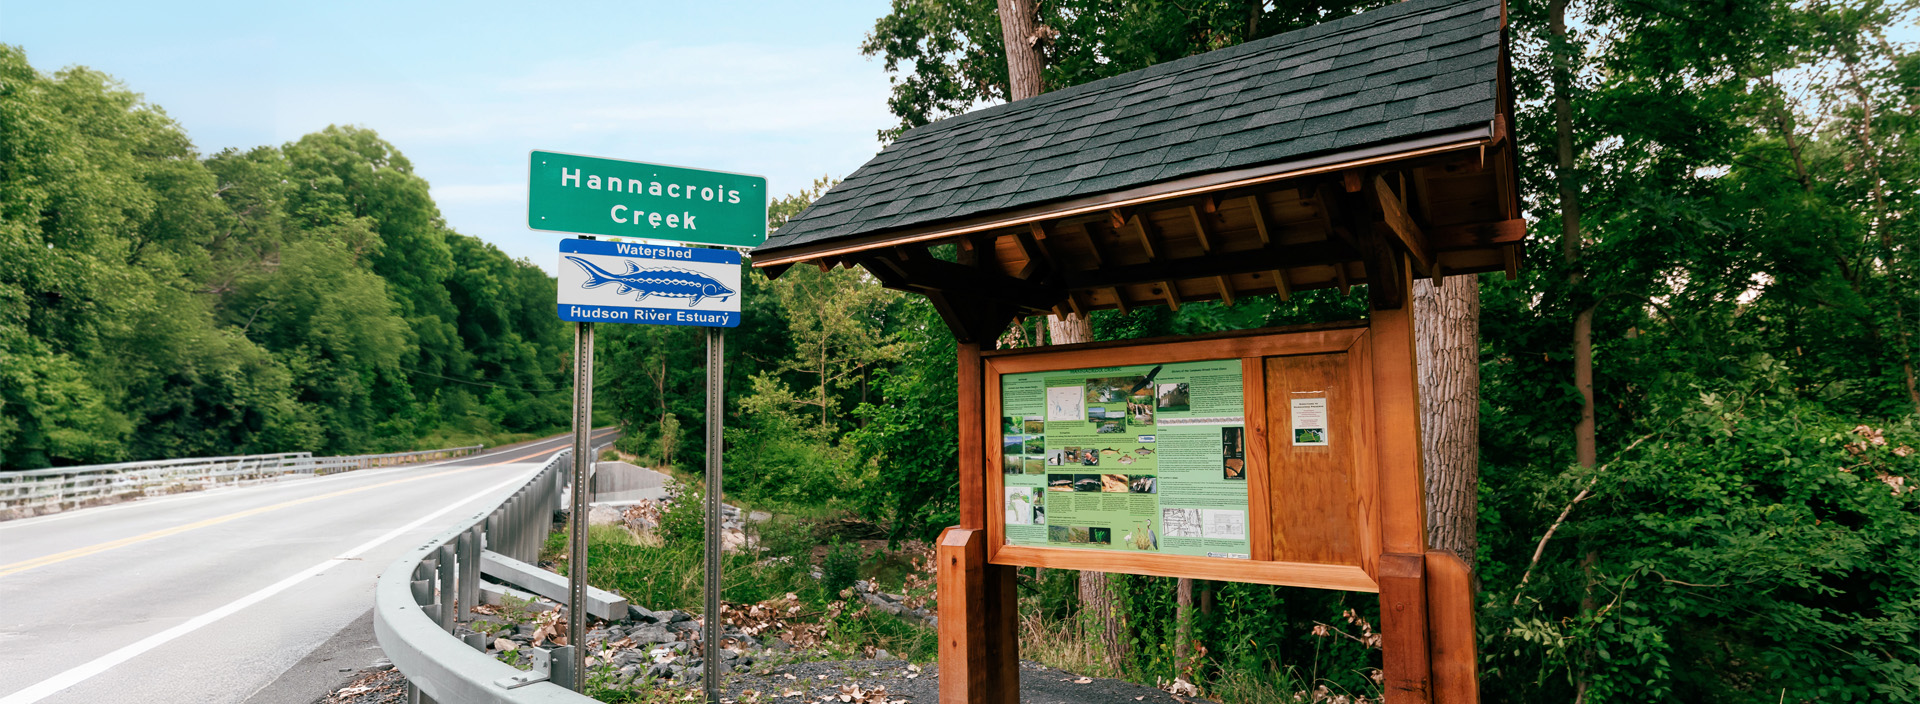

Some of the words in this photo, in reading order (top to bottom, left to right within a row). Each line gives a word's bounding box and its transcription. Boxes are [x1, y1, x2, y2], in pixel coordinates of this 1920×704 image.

[561, 167, 741, 204] Hannacrois
[611, 205, 697, 230] Creek
[617, 243, 692, 259] Watershed
[571, 306, 629, 321] Hudson
[634, 309, 672, 322] River
[677, 311, 729, 325] Estuary
